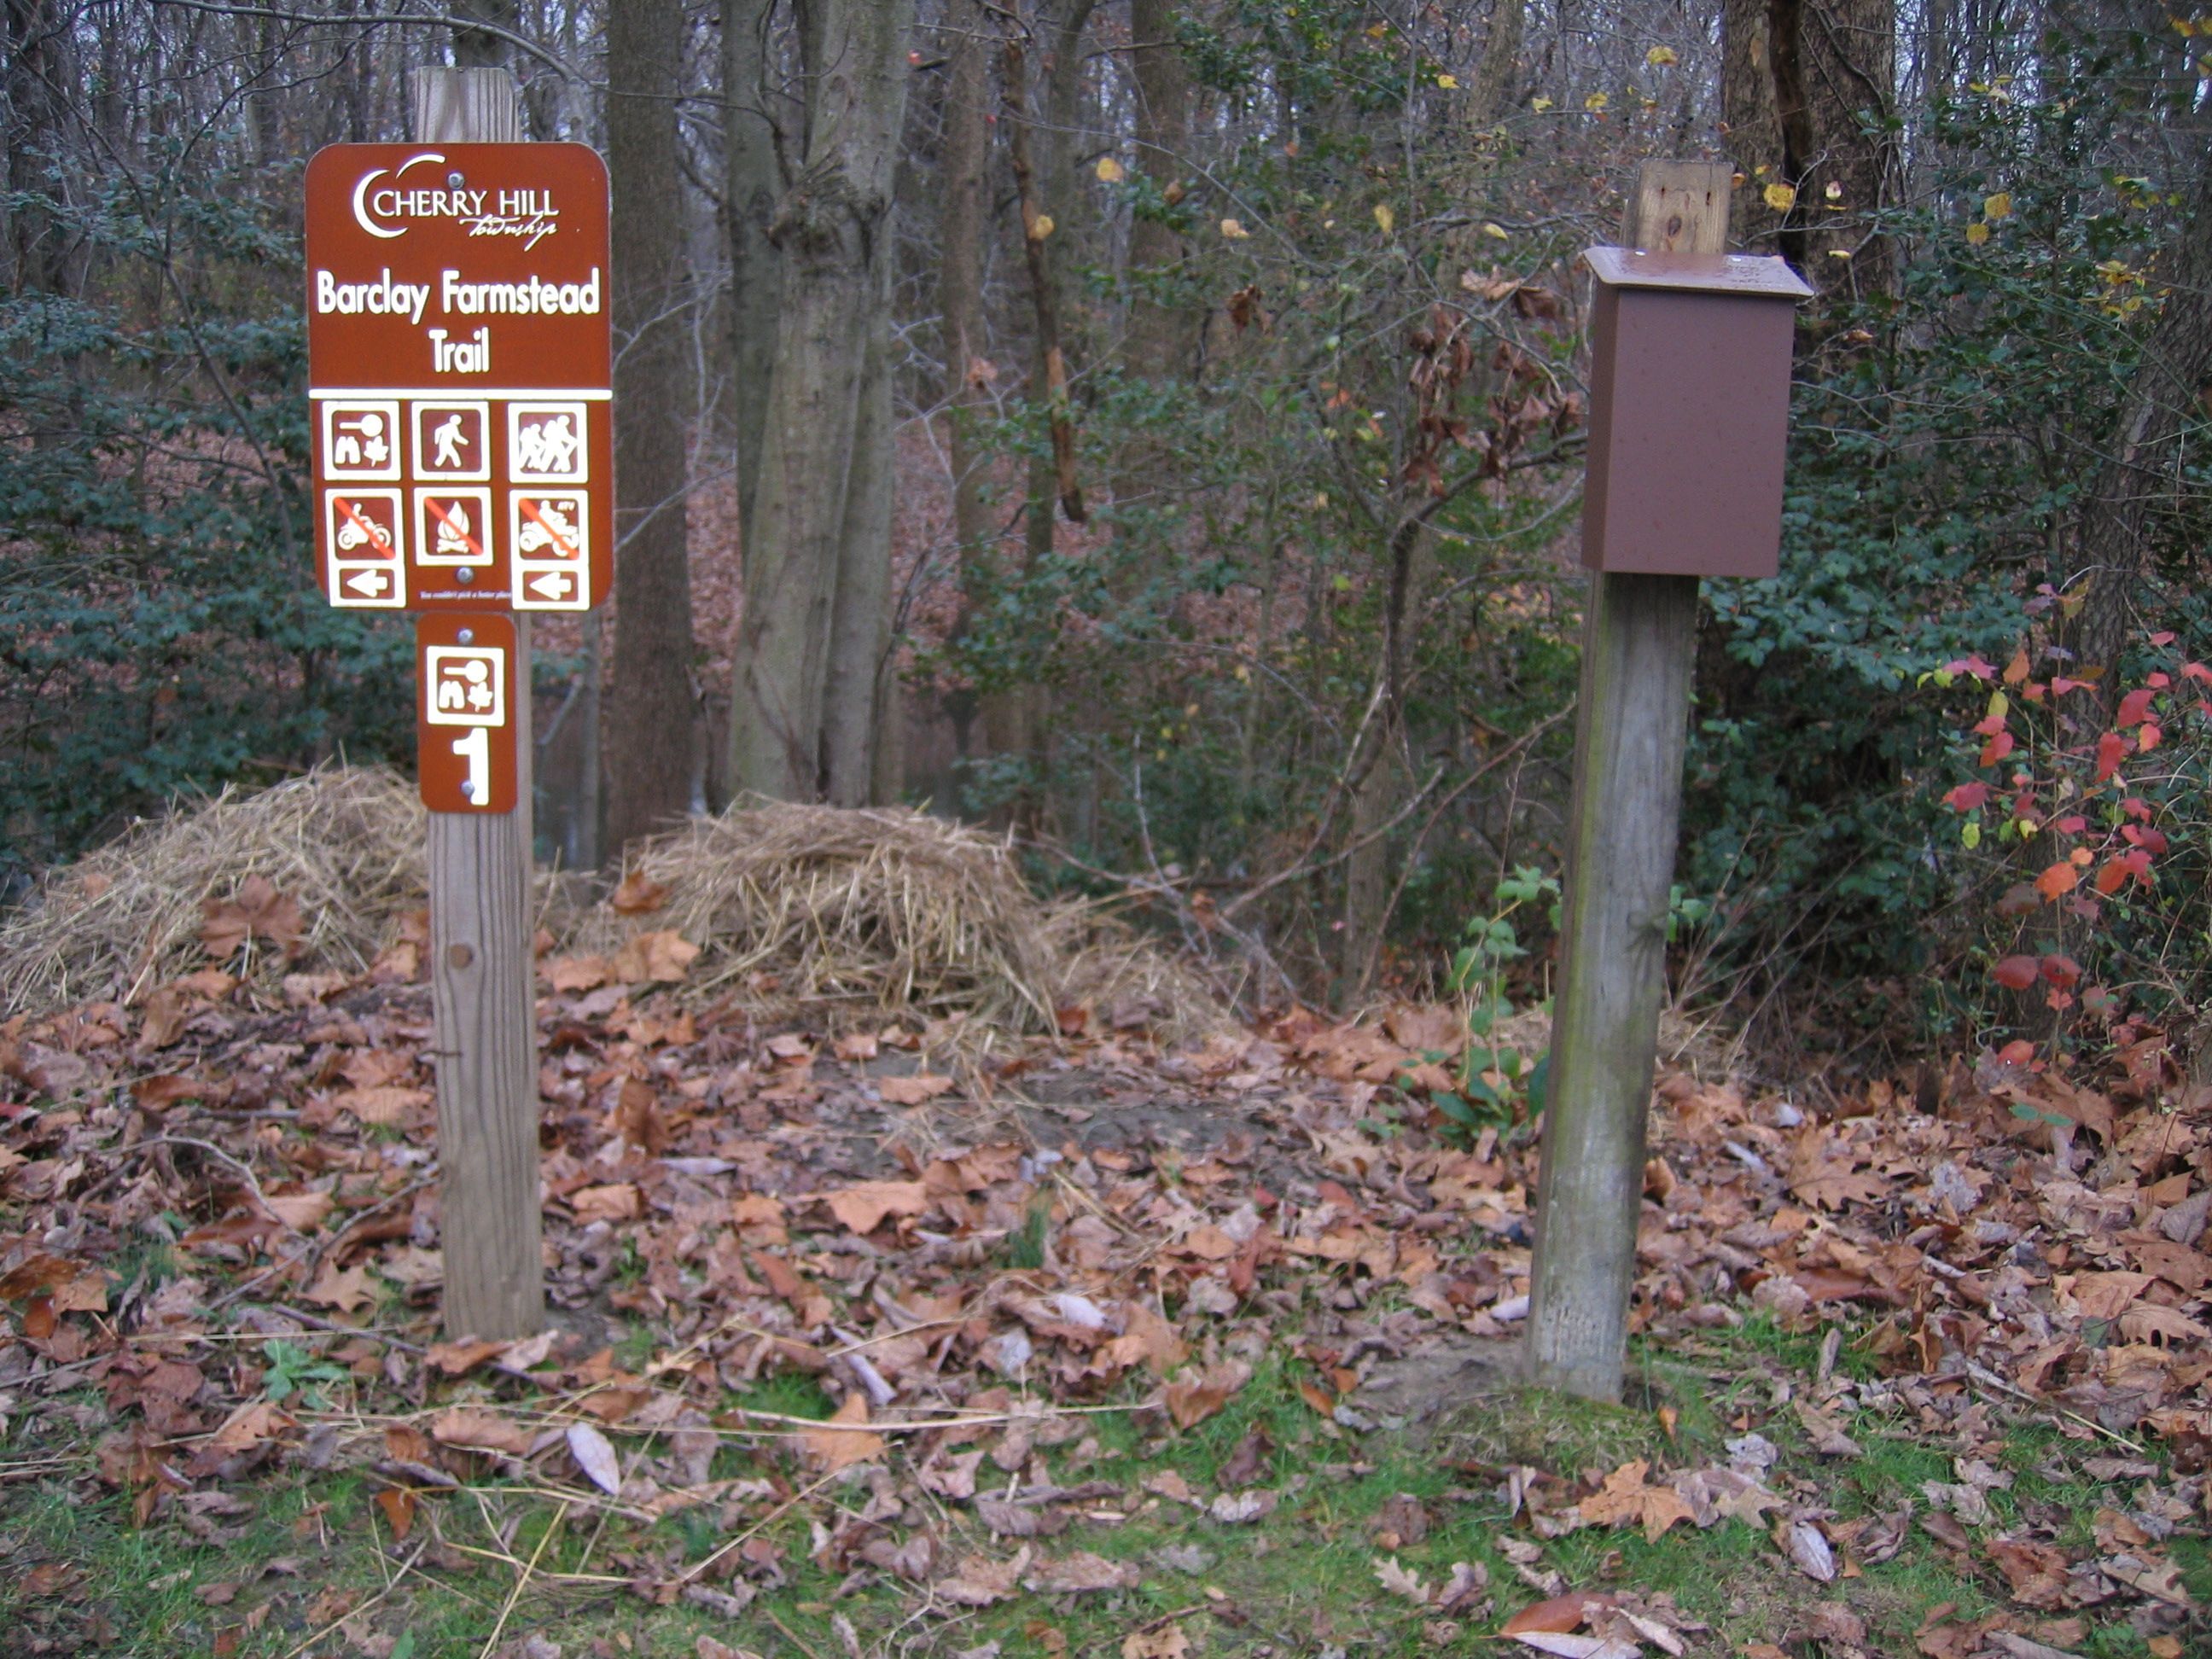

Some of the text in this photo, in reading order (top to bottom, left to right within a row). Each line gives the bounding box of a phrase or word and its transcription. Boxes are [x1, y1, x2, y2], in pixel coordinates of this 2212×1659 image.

[373, 189, 559, 217] CHERRY HILL
[317, 266, 600, 325] Barclay Farmstead
[428, 326, 490, 373] Trail
[452, 727, 489, 806] 1
